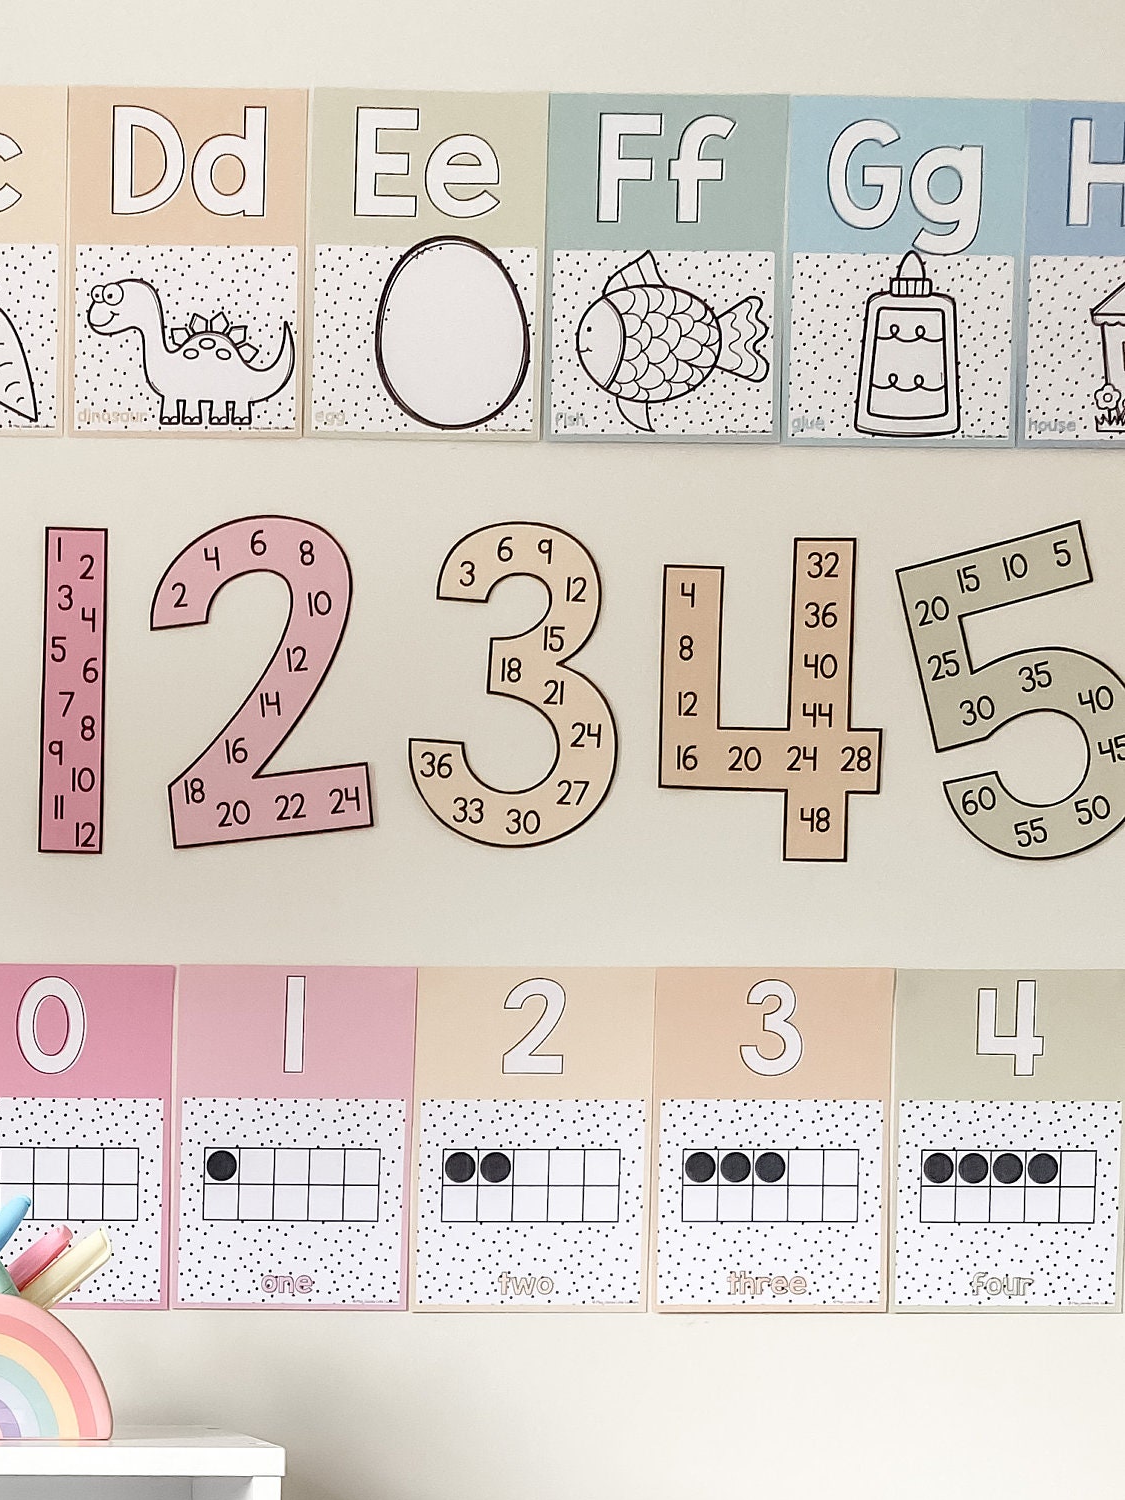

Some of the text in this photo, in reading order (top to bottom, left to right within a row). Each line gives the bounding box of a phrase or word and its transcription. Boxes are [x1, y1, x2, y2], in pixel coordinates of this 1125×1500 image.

[111, 105, 267, 217] Dd
[353, 106, 501, 218] Ee
[596, 112, 737, 223] Ff
[827, 118, 984, 255] Gg
[78, 408, 147, 423] dinosaur
[315, 411, 346, 426] egg
[791, 415, 825, 432] glue
[1028, 417, 1076, 432] house
[57, 536, 62, 563] 1
[250, 529, 267, 556] 6
[299, 539, 315, 566] 8
[497, 536, 514, 563] 6
[537, 538, 553, 565] 9
[79, 554, 95, 580] 2
[203, 546, 221, 572] 4
[807, 551, 840, 579] 32
[956, 539, 1072, 594] 15 10 5
[459, 560, 476, 587] 3
[57, 584, 74, 611] 3
[171, 582, 188, 608] 2
[565, 576, 587, 603] 12
[680, 582, 696, 608] 4
[307, 590, 332, 617] 10
[804, 601, 838, 629] 36
[914, 595, 950, 627] 20
[81, 606, 96, 633] 4
[50, 636, 67, 663] 5
[543, 625, 566, 653] 15
[679, 635, 694, 661] 8
[82, 657, 99, 684] 6
[286, 645, 309, 673] 12
[501, 657, 522, 683] 18
[803, 653, 838, 679] 40
[927, 649, 960, 682] 25
[1018, 660, 1053, 693] 35
[58, 691, 75, 718] 7
[259, 691, 281, 718] 14
[543, 679, 565, 706] 21
[678, 691, 698, 717] 12
[1077, 685, 1114, 714] 40
[802, 702, 833, 728] 44
[959, 695, 995, 726] 30
[80, 715, 96, 742] 8
[570, 722, 602, 749] 24
[48, 740, 63, 766] 9
[225, 737, 248, 765] 16
[676, 744, 872, 772] 16 20 24 28
[1097, 734, 1125, 763] 45
[419, 751, 453, 779] 36
[71, 767, 96, 793] 10
[184, 777, 206, 805] 18
[556, 779, 590, 806] 27
[54, 794, 64, 820] 11
[216, 799, 251, 828] 20
[274, 792, 307, 821] 22
[328, 786, 361, 815] 24
[452, 796, 484, 825] 33
[961, 786, 996, 816] 60
[1074, 794, 1111, 825] 50
[505, 808, 541, 835] 30
[800, 807, 831, 833] 48
[1013, 816, 1048, 848] 55
[75, 821, 96, 848] 12
[16, 975, 86, 1075] 0
[501, 978, 566, 1074] 2
[740, 979, 803, 1077] 3
[976, 980, 1044, 1076] 4
[261, 1275, 313, 1294] one
[498, 1271, 554, 1295] two
[727, 1270, 807, 1295] three
[972, 1271, 1035, 1296] four
